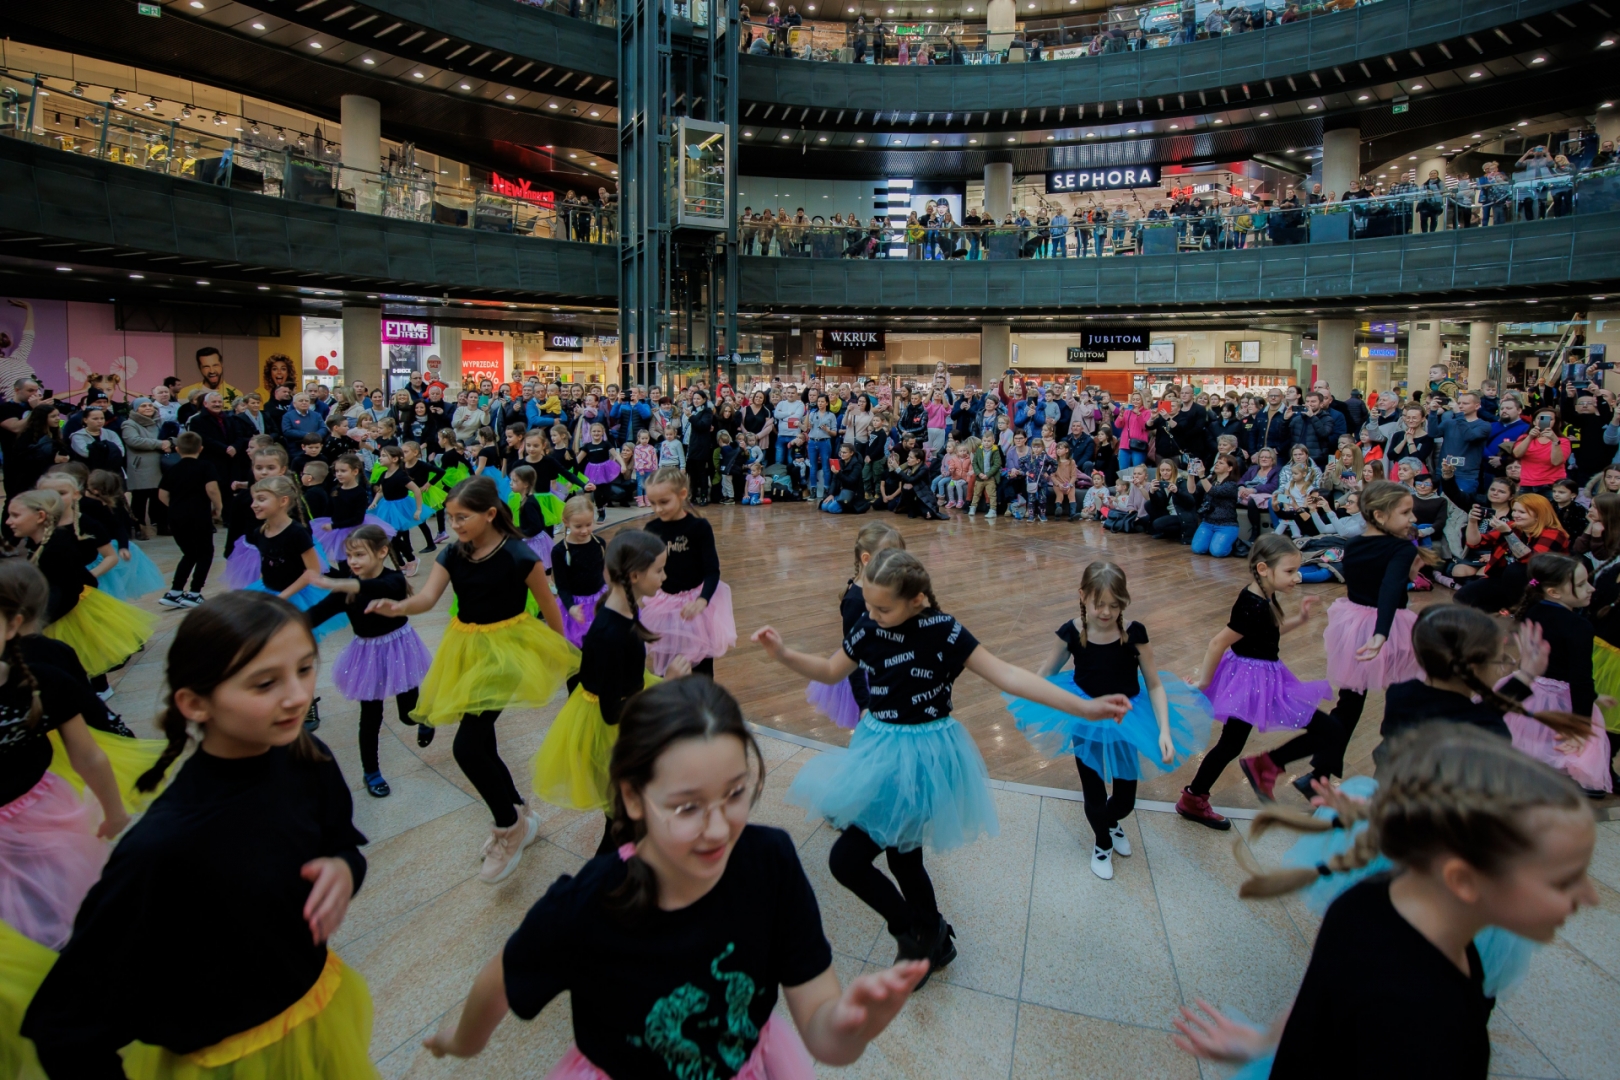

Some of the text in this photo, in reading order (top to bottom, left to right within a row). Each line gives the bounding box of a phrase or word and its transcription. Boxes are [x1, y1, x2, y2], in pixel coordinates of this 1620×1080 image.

[1053, 169, 1152, 189] SEPHORA
[1193, 183, 1210, 193] HUB
[400, 322, 428, 333] TIME
[552, 336, 579, 348] OCHNIK
[462, 360, 499, 369] WYPRZEDAŻ
[876, 628, 905, 644] STYLISH
[884, 650, 915, 669] FASHION
[910, 667, 934, 680] CHIC
